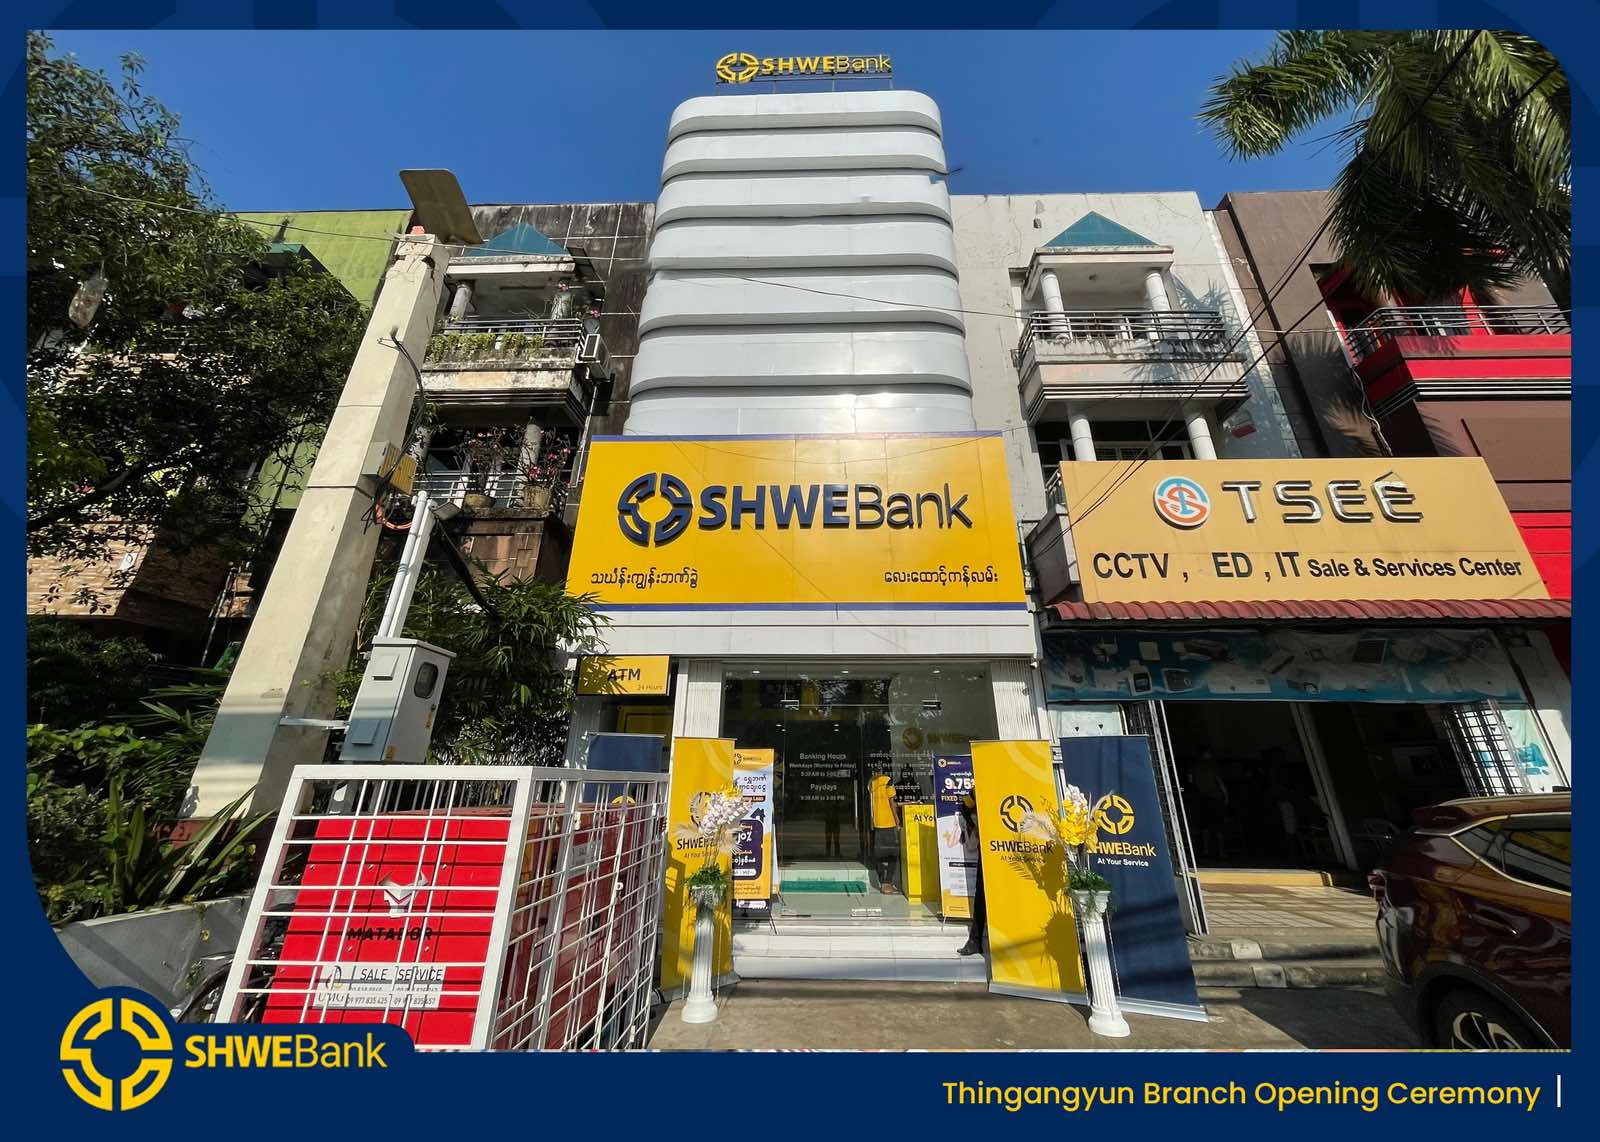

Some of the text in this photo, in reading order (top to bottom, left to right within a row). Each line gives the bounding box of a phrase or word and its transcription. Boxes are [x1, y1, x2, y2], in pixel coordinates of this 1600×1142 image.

[762, 54, 892, 75] SHWEBank
[698, 483, 973, 530] SHWEBank
[1309, 558, 1350, 577] Sale
[1353, 558, 1370, 577] &
[1372, 558, 1456, 577] Services
[1458, 557, 1522, 577] Center
[607, 668, 641, 681] ATM
[800, 753, 826, 761] Banking
[810, 783, 837, 791] Paydays
[990, 840, 1054, 854] SHWEBank
[1088, 841, 1157, 857] HWEBank
[1097, 857, 1149, 867] At Your Service
[360, 968, 389, 981] SALE
